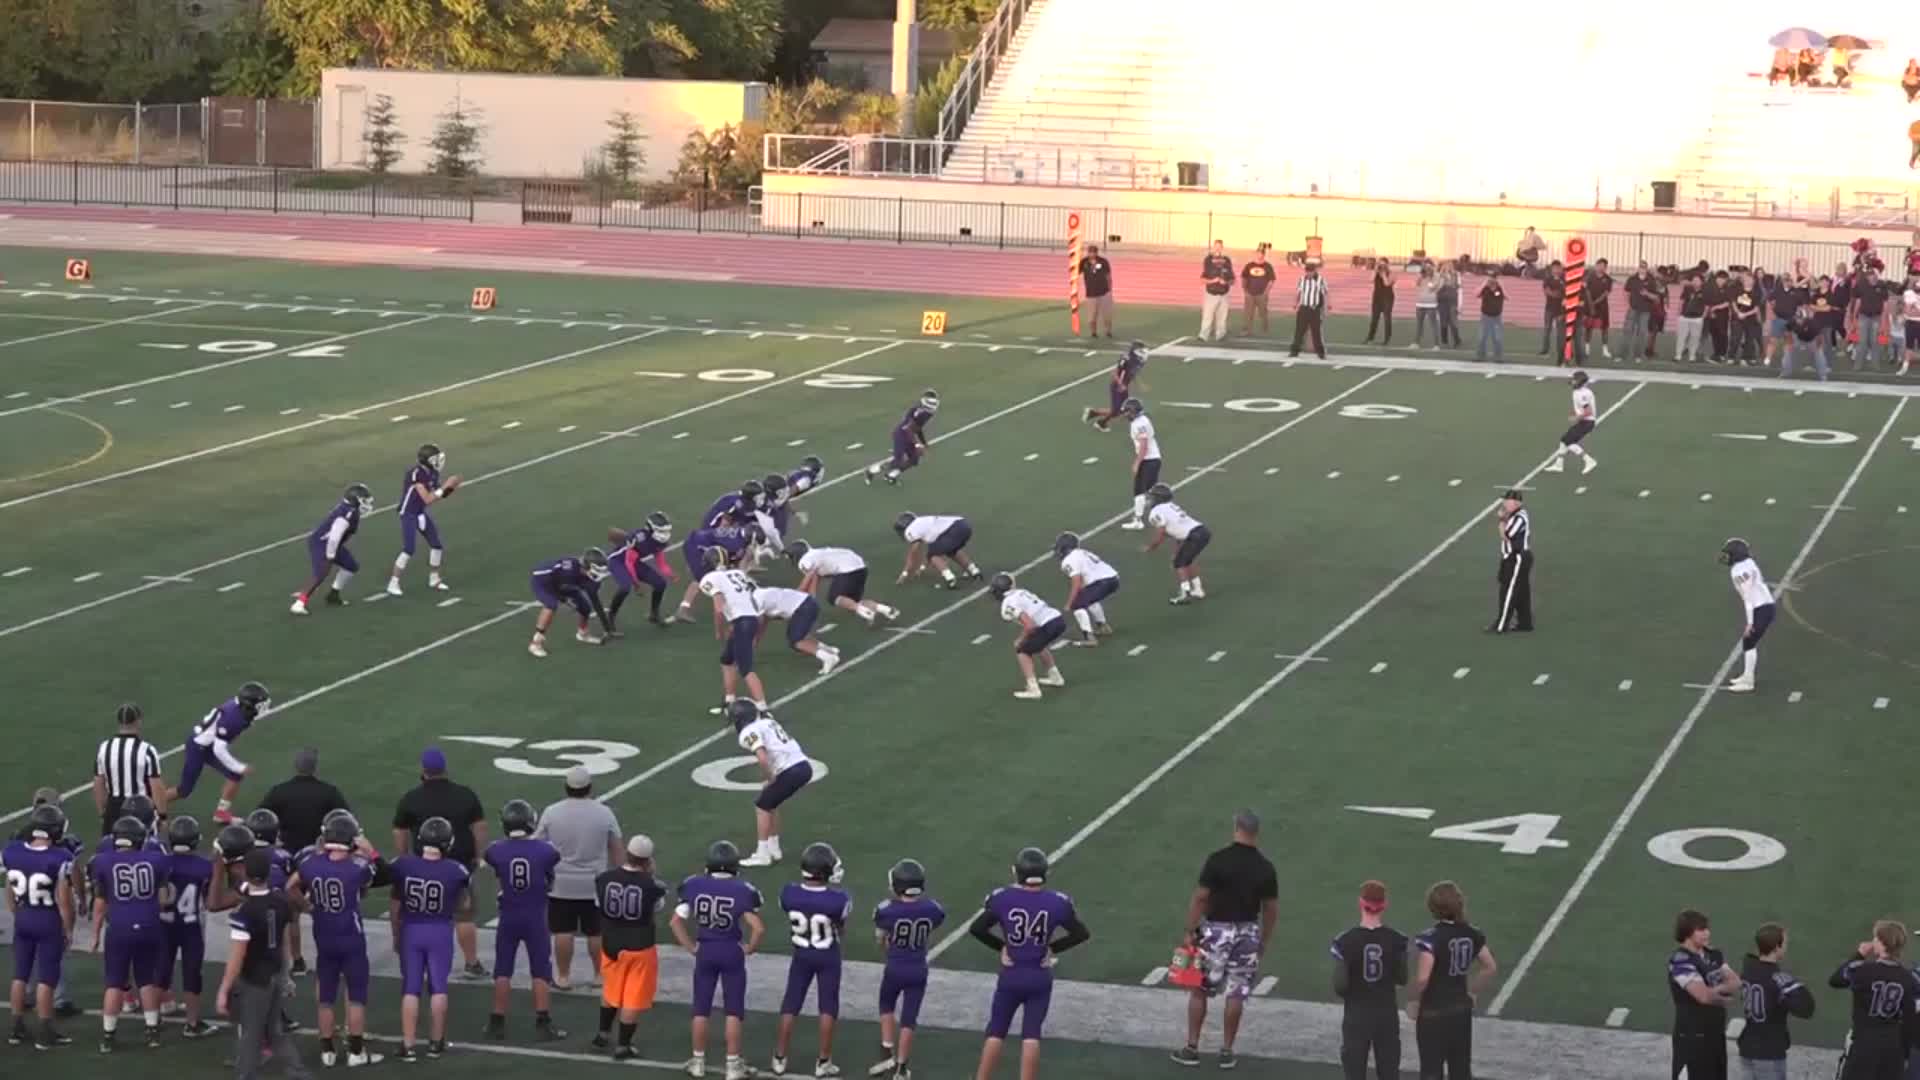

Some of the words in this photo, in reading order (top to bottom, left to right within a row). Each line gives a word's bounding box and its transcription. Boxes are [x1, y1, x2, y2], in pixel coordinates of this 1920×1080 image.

[69, 261, 83, 277] G
[474, 289, 491, 306] 10
[925, 314, 941, 331] 20
[112, 862, 154, 901] 60
[511, 857, 530, 893] 8
[312, 877, 345, 913] 18
[405, 876, 443, 913] 58
[604, 881, 643, 921] 60
[694, 894, 734, 932] 85
[789, 911, 833, 949] 20
[894, 918, 932, 951] 80
[1008, 908, 1048, 946] 34
[1363, 943, 1383, 983] 6
[1448, 937, 1473, 977] 10
[1869, 980, 1905, 1018] 18
